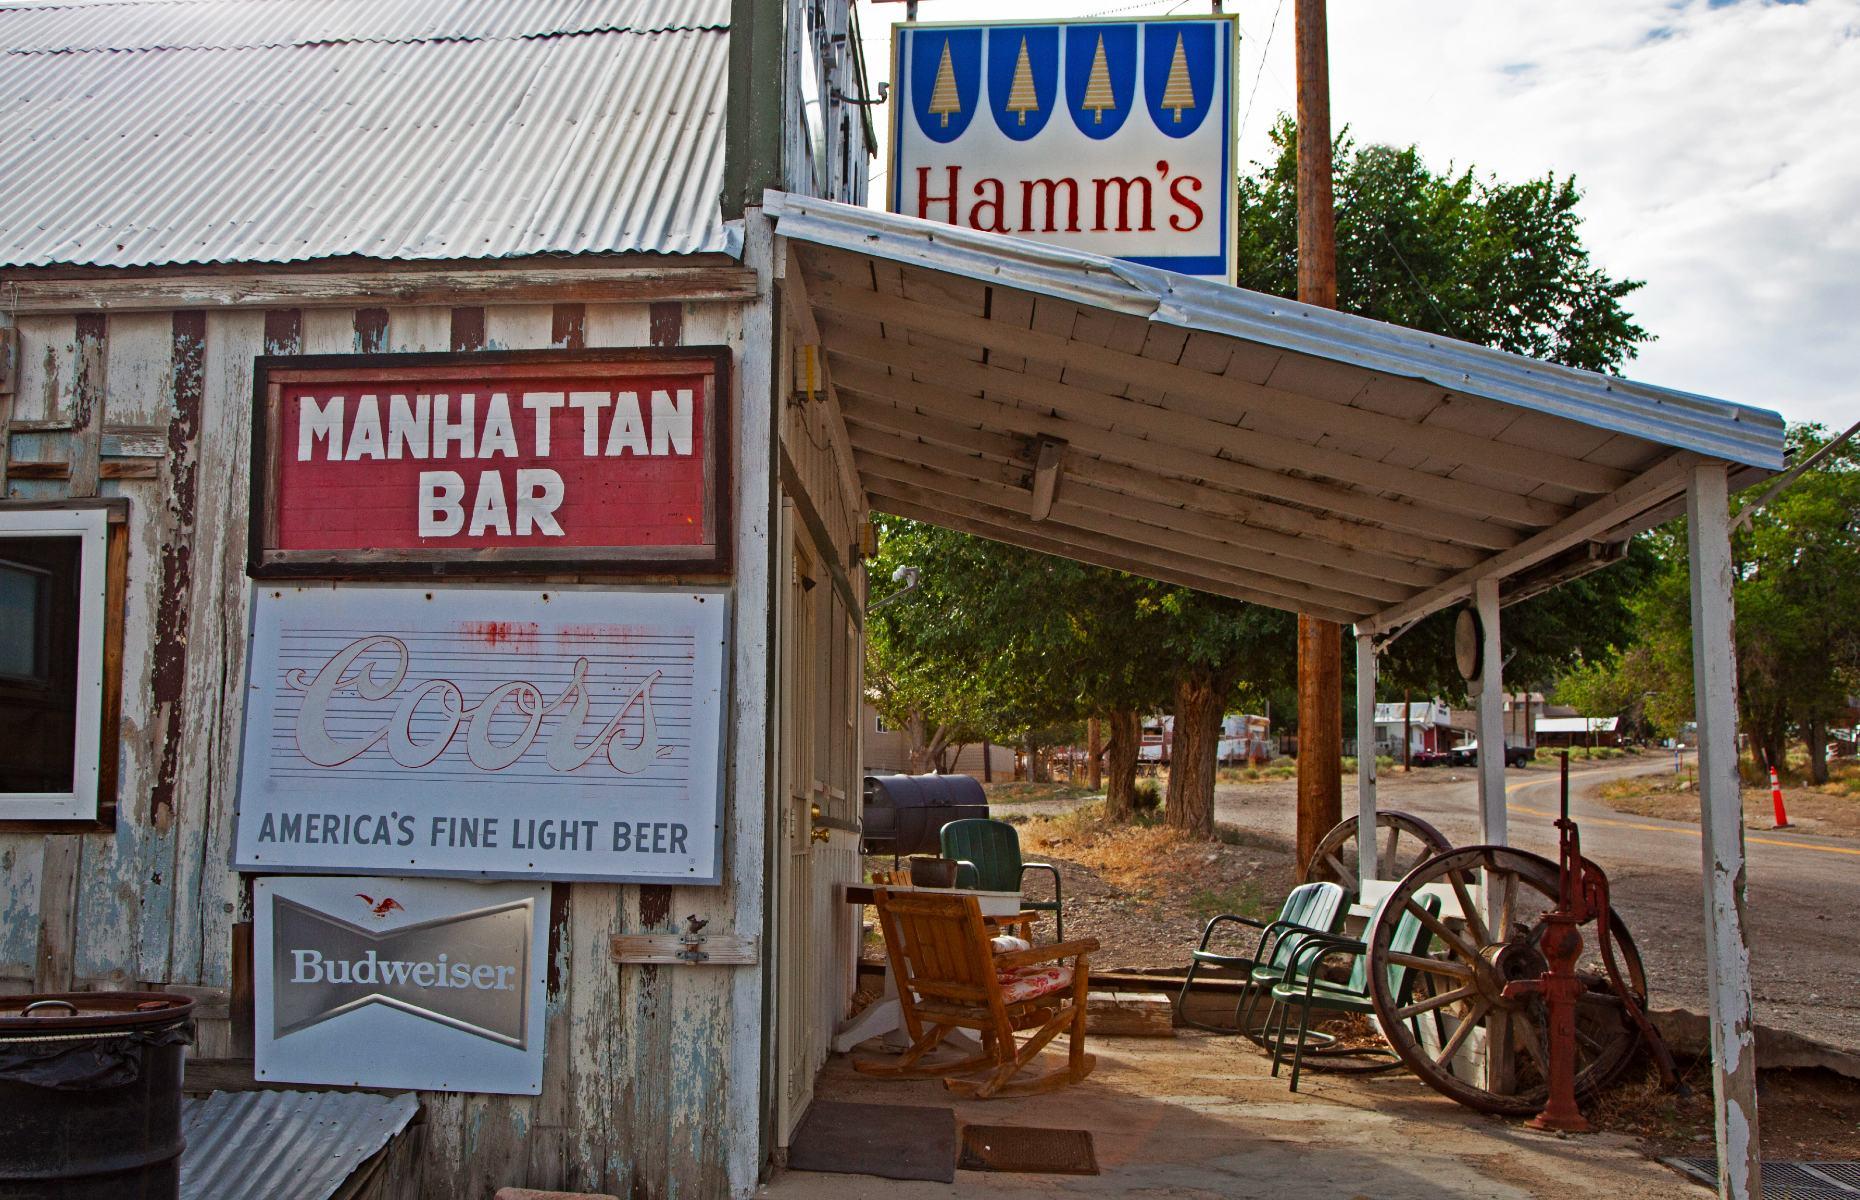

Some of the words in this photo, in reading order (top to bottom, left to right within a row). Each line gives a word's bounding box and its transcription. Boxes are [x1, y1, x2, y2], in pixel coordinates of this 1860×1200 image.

[915, 159, 1204, 233] Hamm's
[297, 389, 694, 462] MANHATTAN
[418, 468, 566, 538] BAR
[285, 634, 664, 775] Coors
[257, 810, 415, 847] AMERICA'S
[430, 816, 499, 849] FINE
[511, 818, 600, 852] LIGHT
[611, 821, 689, 854] BEER
[290, 949, 516, 990] Budweiser
